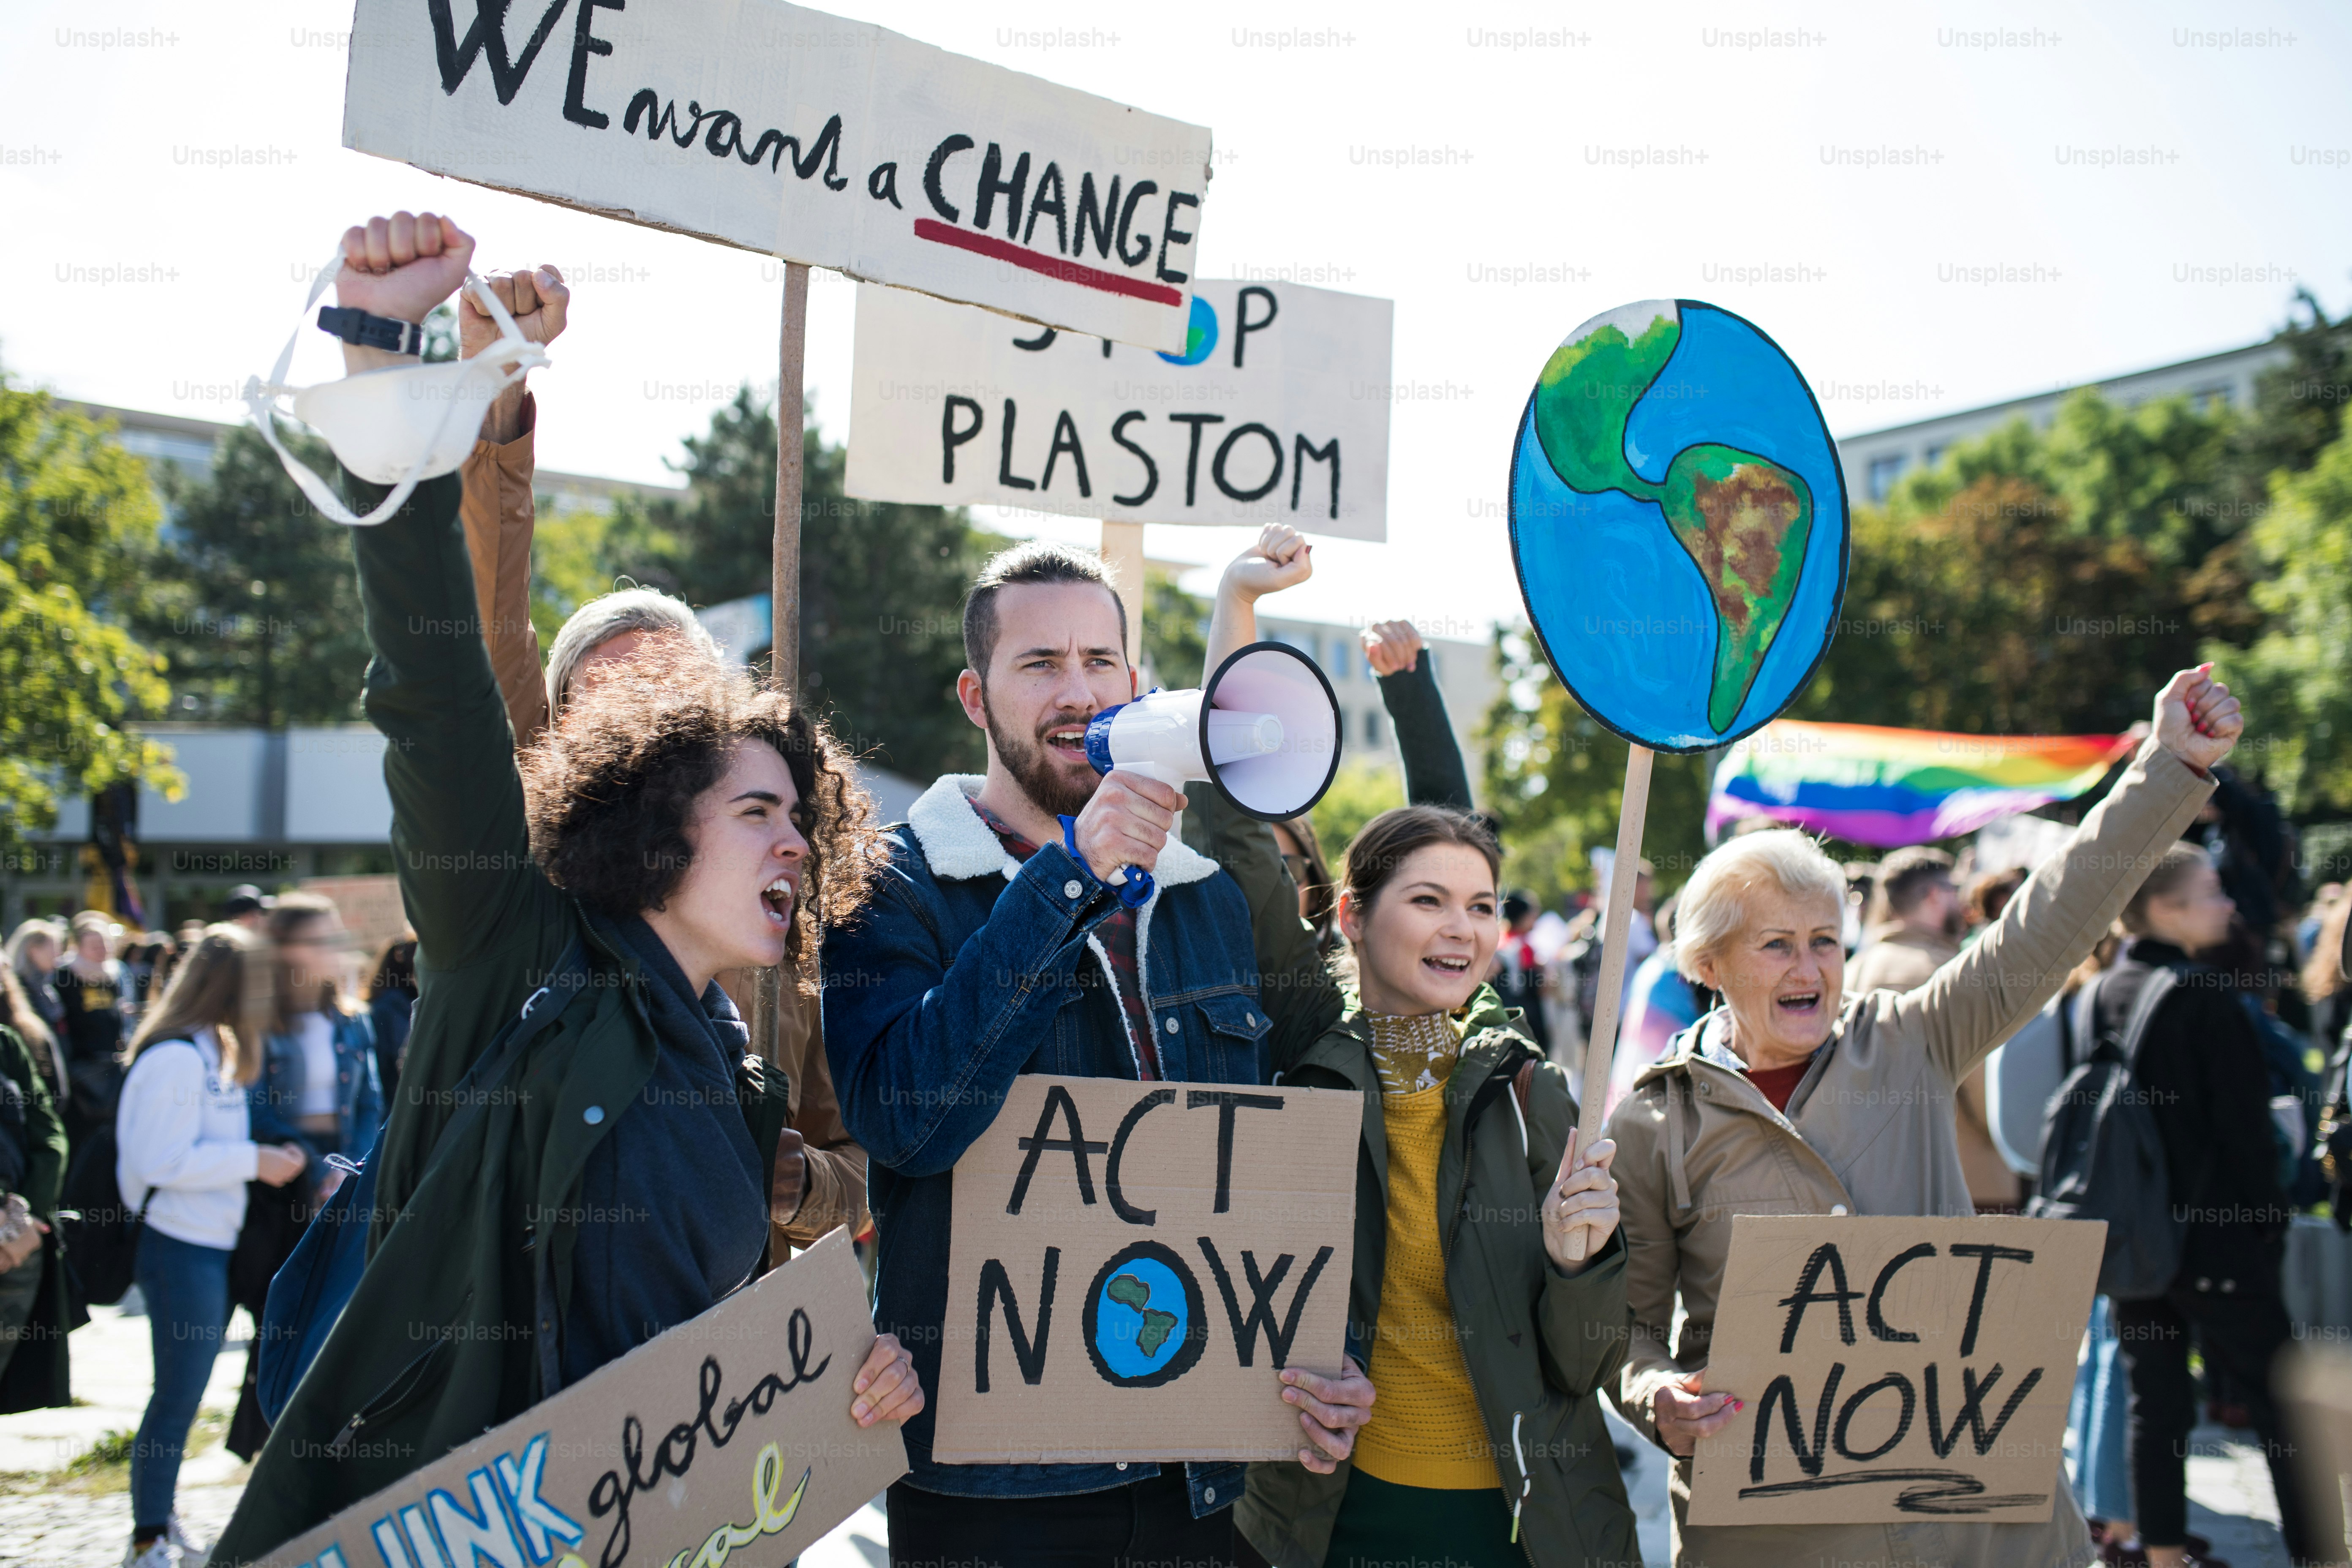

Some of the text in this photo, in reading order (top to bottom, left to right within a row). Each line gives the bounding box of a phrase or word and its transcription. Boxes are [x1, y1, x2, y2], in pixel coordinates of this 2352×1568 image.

[428, 0, 625, 129] WE
[868, 162, 903, 210] a
[923, 134, 1199, 284] CHANGE
[942, 395, 1340, 520] PLASTOM
[1006, 1085, 1284, 1226] ACT
[975, 1236, 1334, 1394] NOW
[1777, 1242, 2035, 1358] ACT
[588, 1307, 833, 1568] global
[1749, 1361, 2044, 1483] NOW
